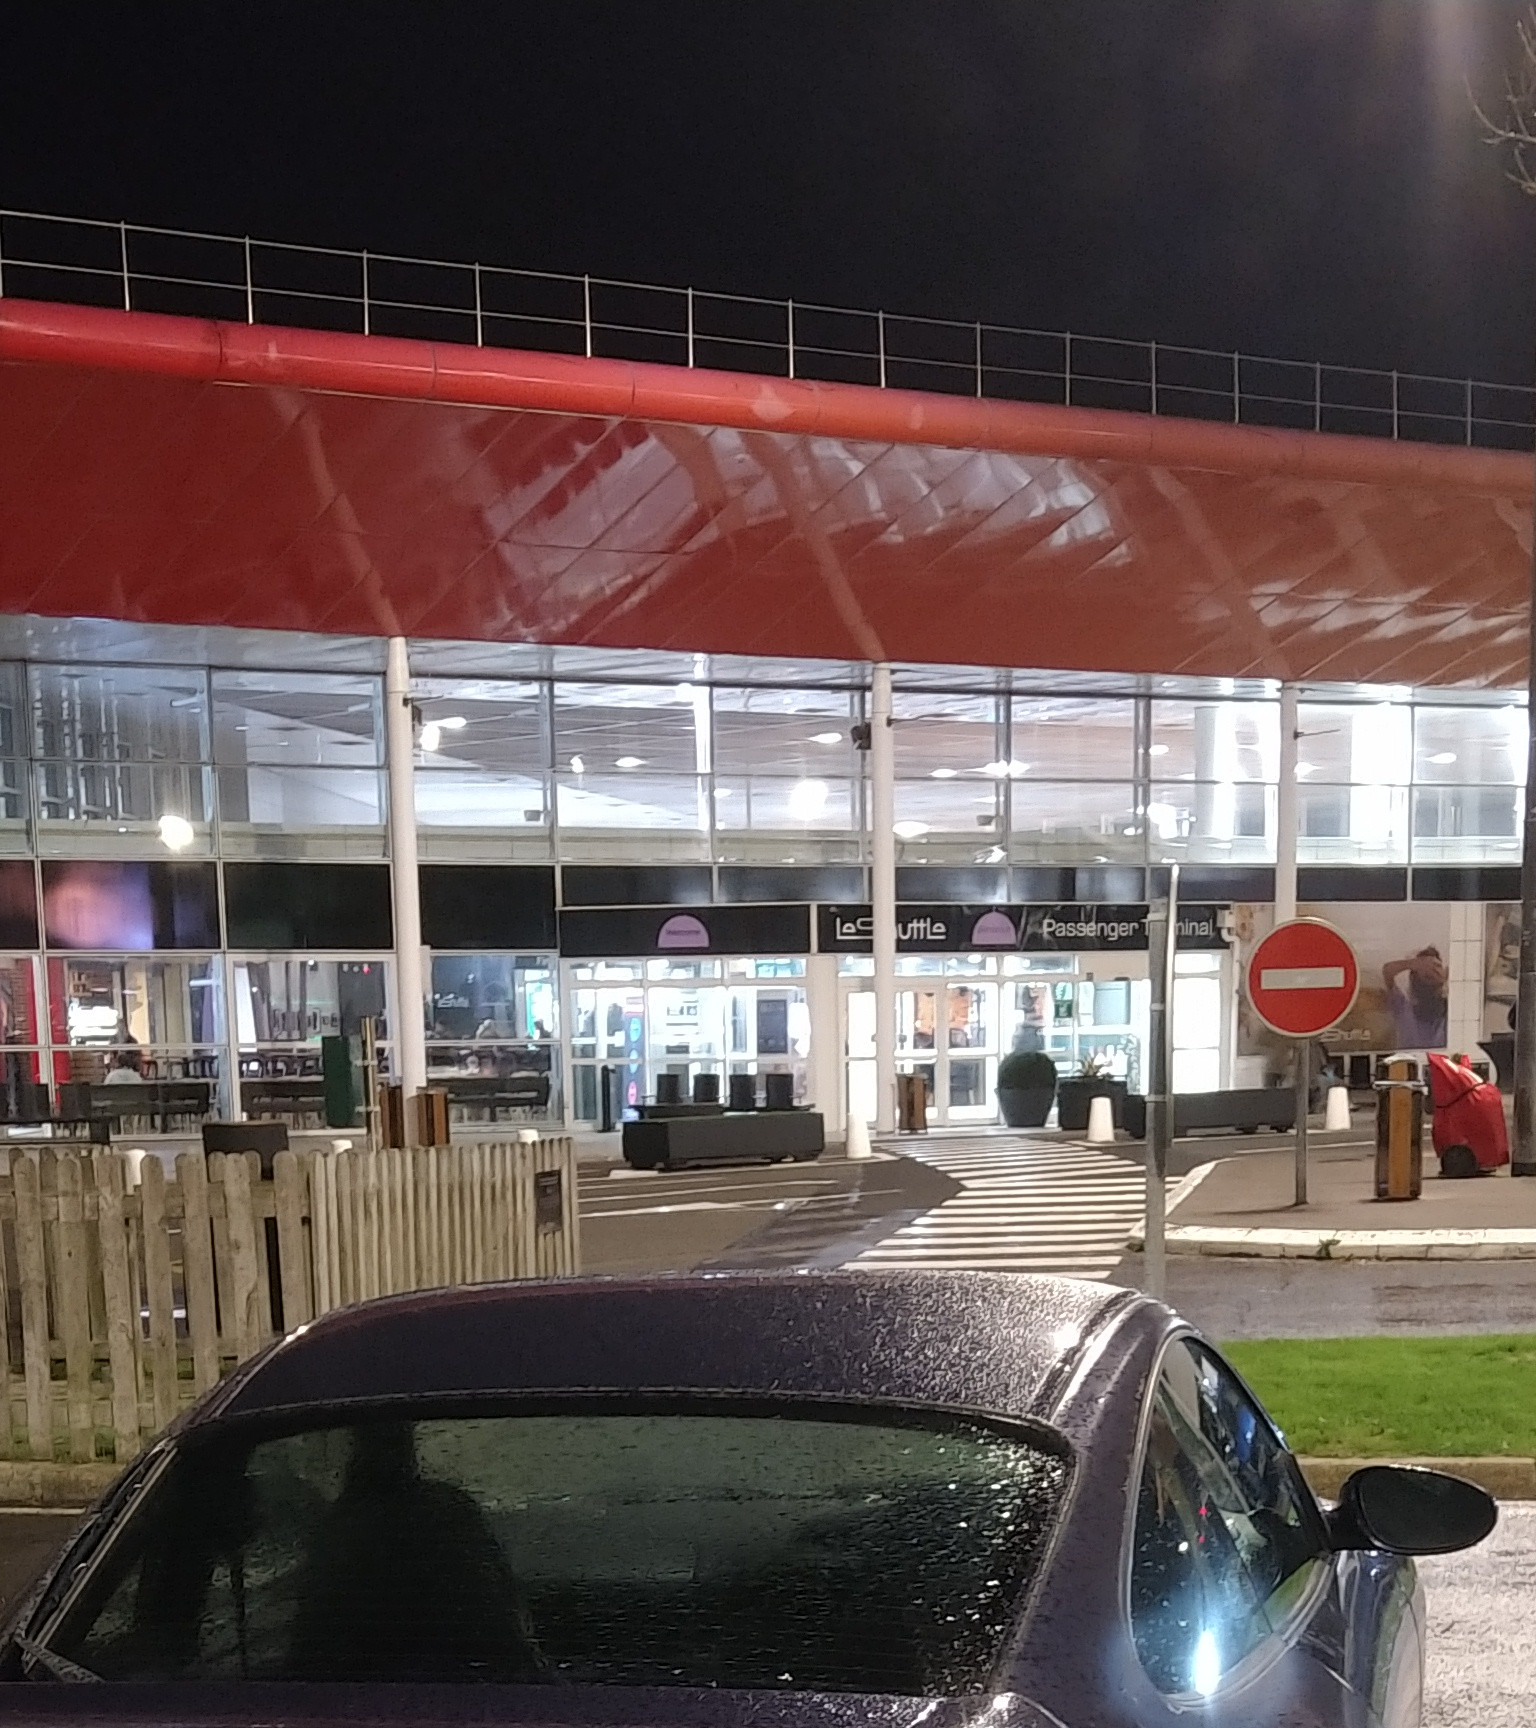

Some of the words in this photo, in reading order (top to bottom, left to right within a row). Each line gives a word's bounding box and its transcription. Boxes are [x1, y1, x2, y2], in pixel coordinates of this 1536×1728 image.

[836, 917, 946, 940] LeSuttle
[1043, 919, 1139, 941] Passenger
[1140, 918, 1213, 936] Tminal
